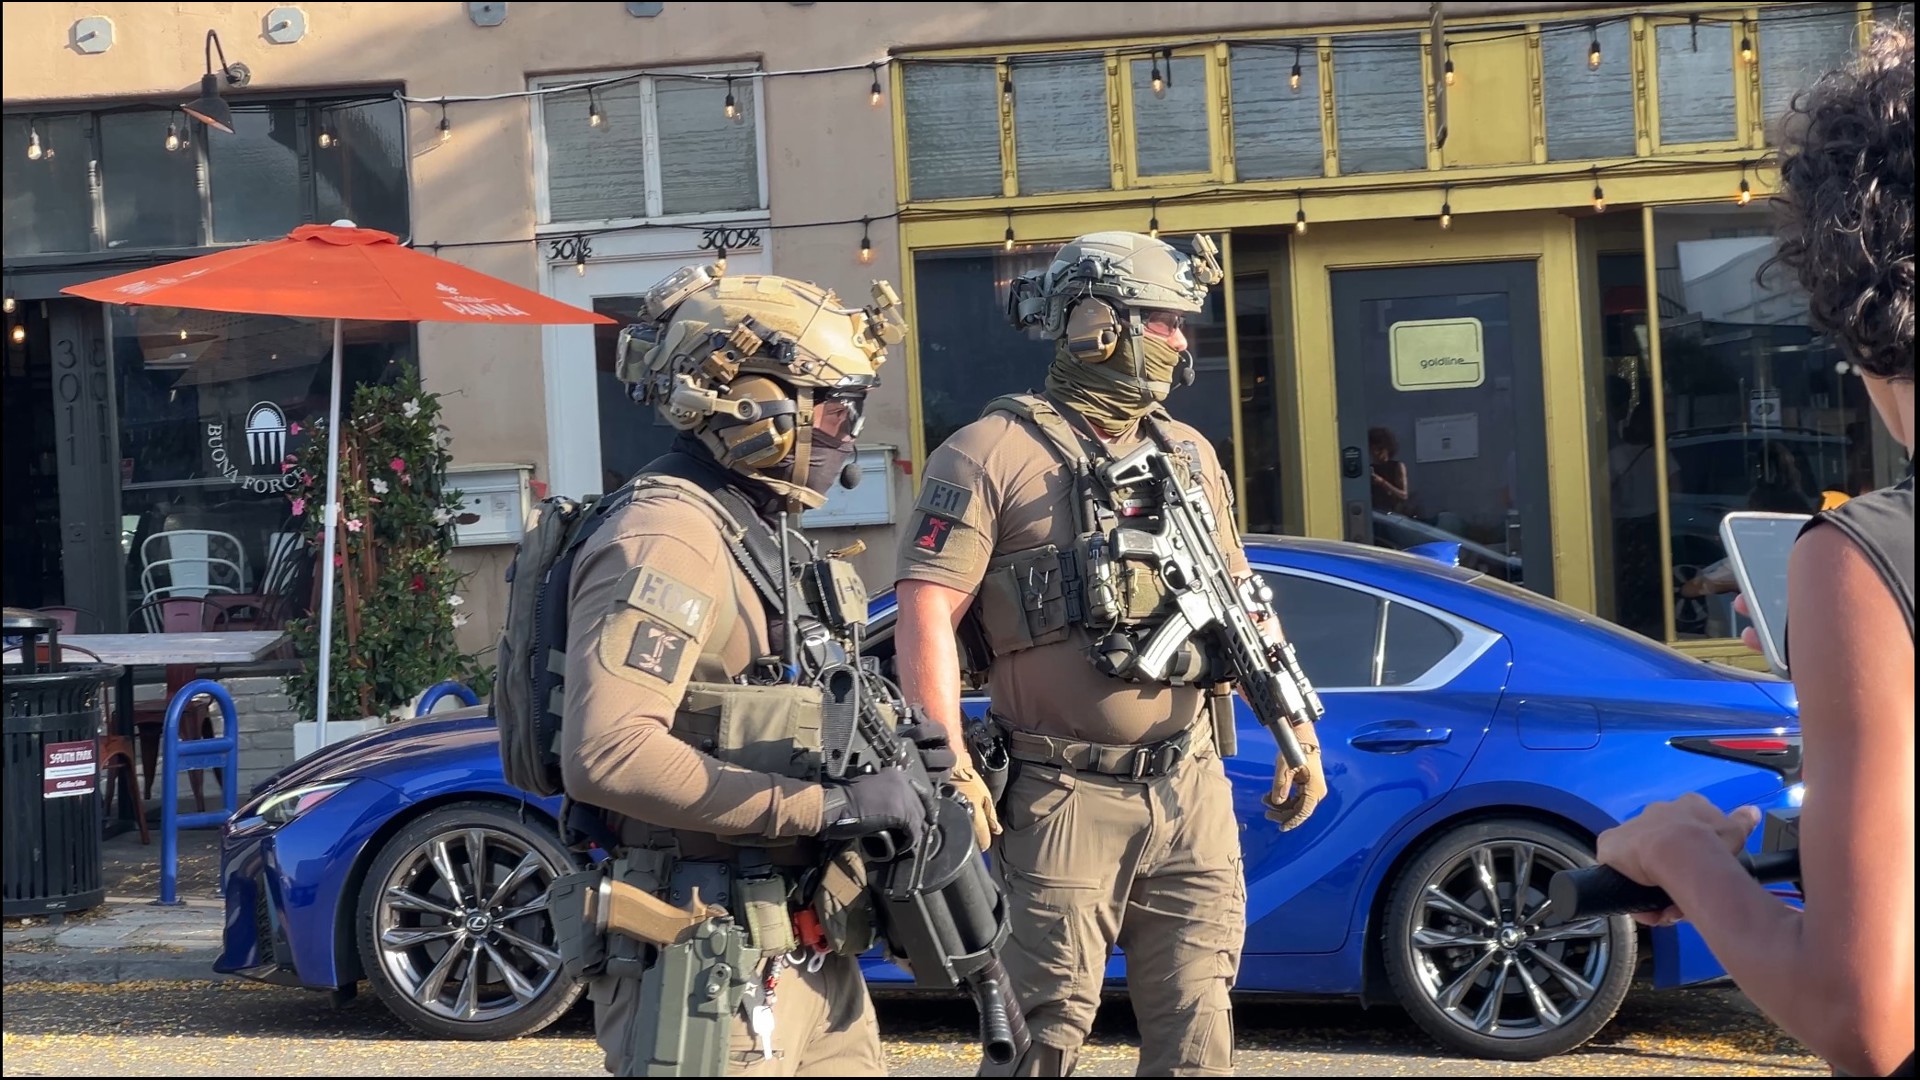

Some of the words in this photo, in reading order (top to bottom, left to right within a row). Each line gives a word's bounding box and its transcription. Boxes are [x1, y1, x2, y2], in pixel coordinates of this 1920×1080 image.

[1420, 357, 1465, 369] goldline
[57, 339, 79, 466] 3011
[207, 423, 239, 483] BUONA
[930, 485, 961, 511] E11
